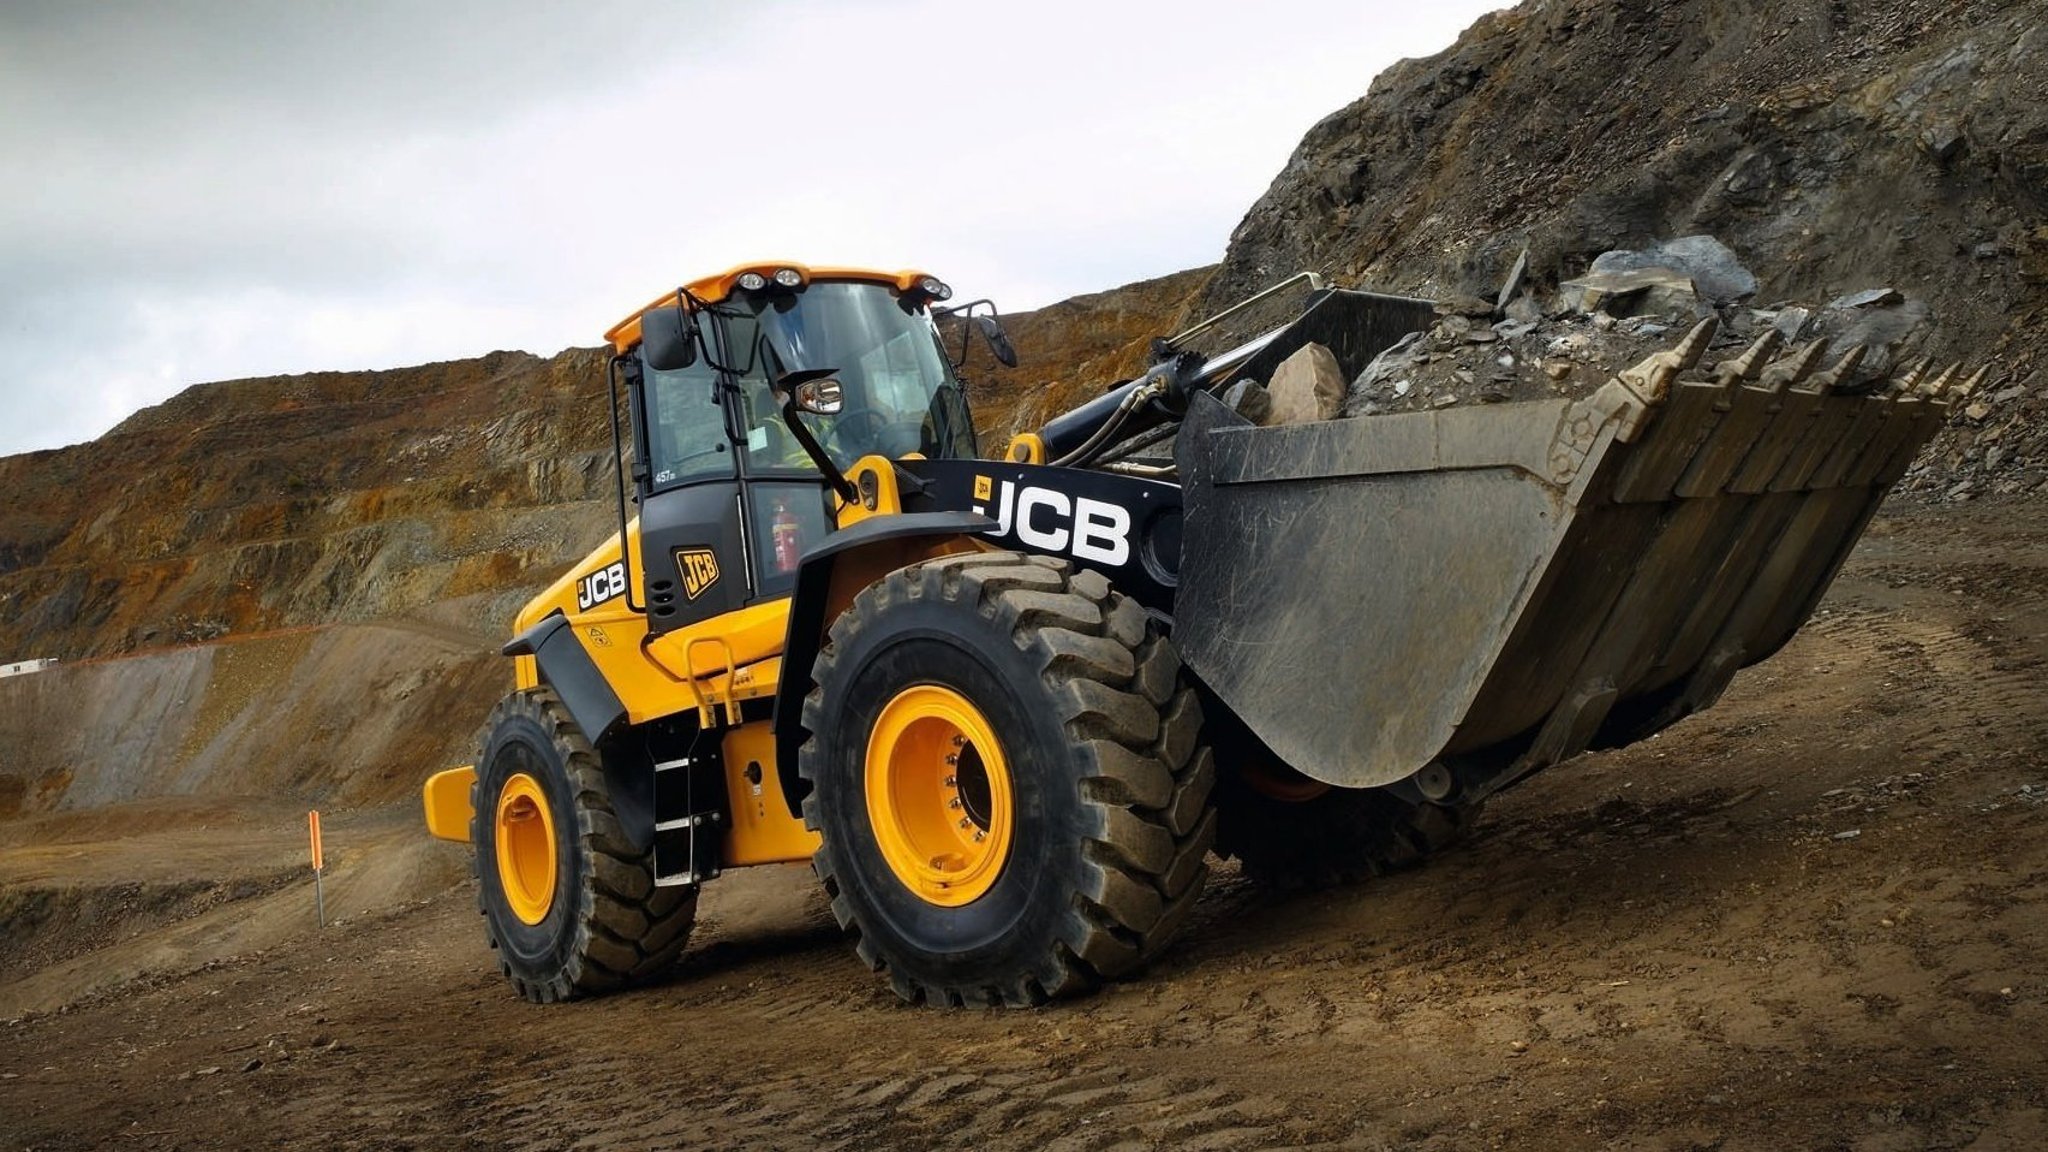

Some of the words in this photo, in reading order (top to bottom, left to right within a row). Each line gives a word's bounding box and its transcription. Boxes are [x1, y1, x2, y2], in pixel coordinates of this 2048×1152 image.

[973, 480, 1131, 566] JCB
[579, 562, 626, 609] JCB
[683, 553, 717, 594] JCB
